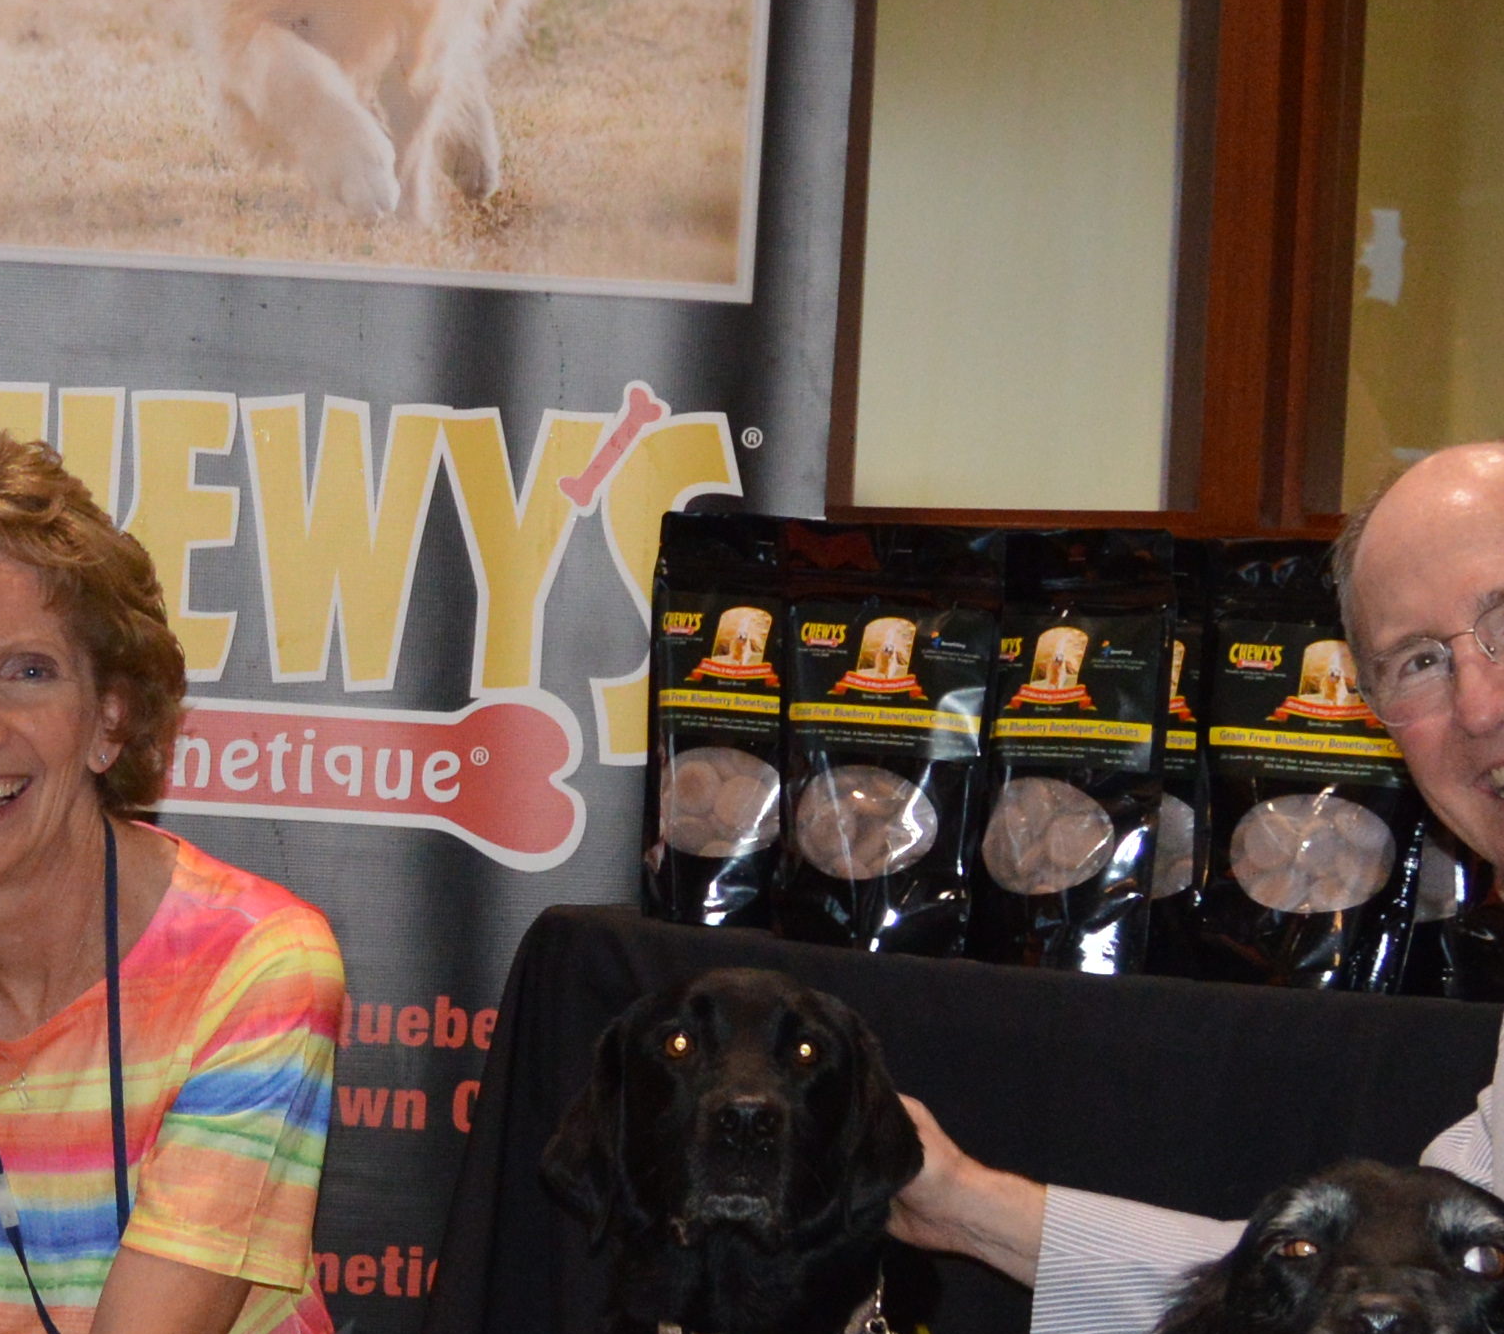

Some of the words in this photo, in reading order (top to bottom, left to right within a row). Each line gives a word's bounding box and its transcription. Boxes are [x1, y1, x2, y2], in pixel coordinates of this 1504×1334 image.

[1098, 725, 1140, 738] Cookies
[1219, 730, 1246, 742] Grain
[1249, 732, 1272, 743] Free
[1275, 734, 1326, 749] Blueberry
[1329, 738, 1382, 755] Bonetique
[172, 729, 461, 803] netique
